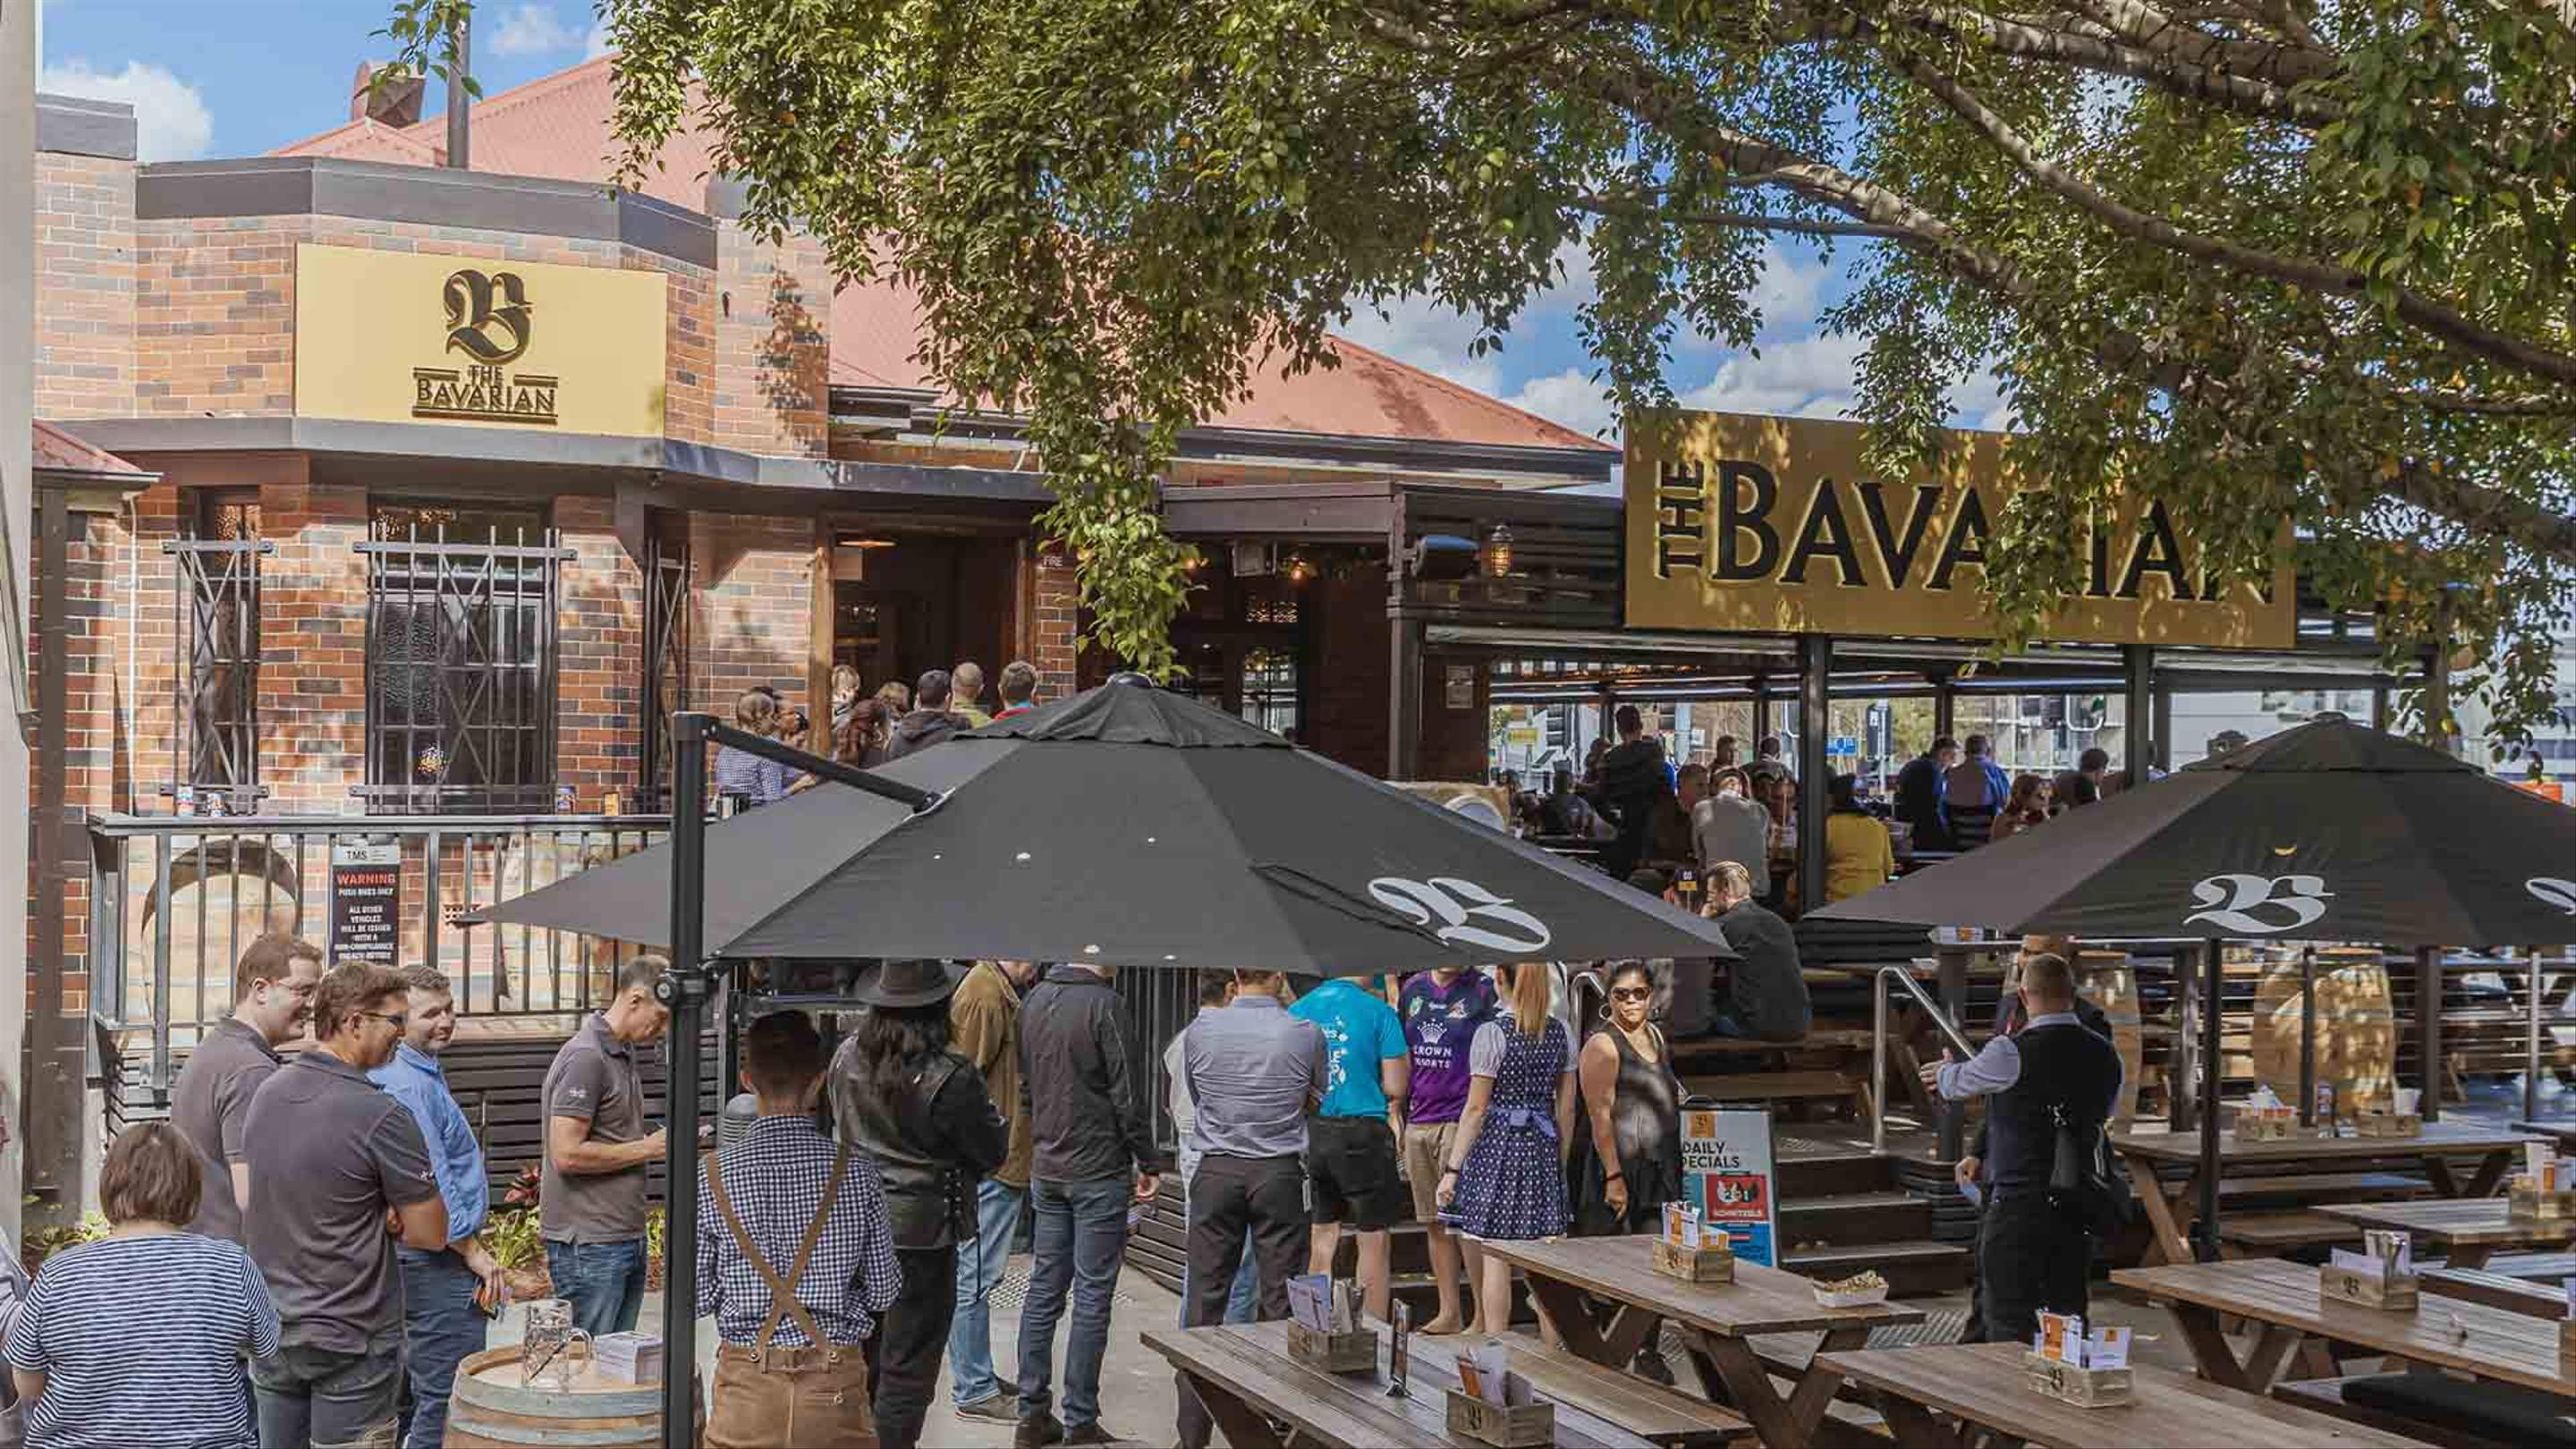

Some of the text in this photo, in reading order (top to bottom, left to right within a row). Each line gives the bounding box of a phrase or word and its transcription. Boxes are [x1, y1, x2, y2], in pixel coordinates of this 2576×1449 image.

[468, 364, 503, 386] THE
[417, 377, 555, 412] BAVARIAN
[1655, 459, 1704, 580] THE
[347, 851, 368, 860] TMS
[1682, 1141, 1725, 1154] DAILY
